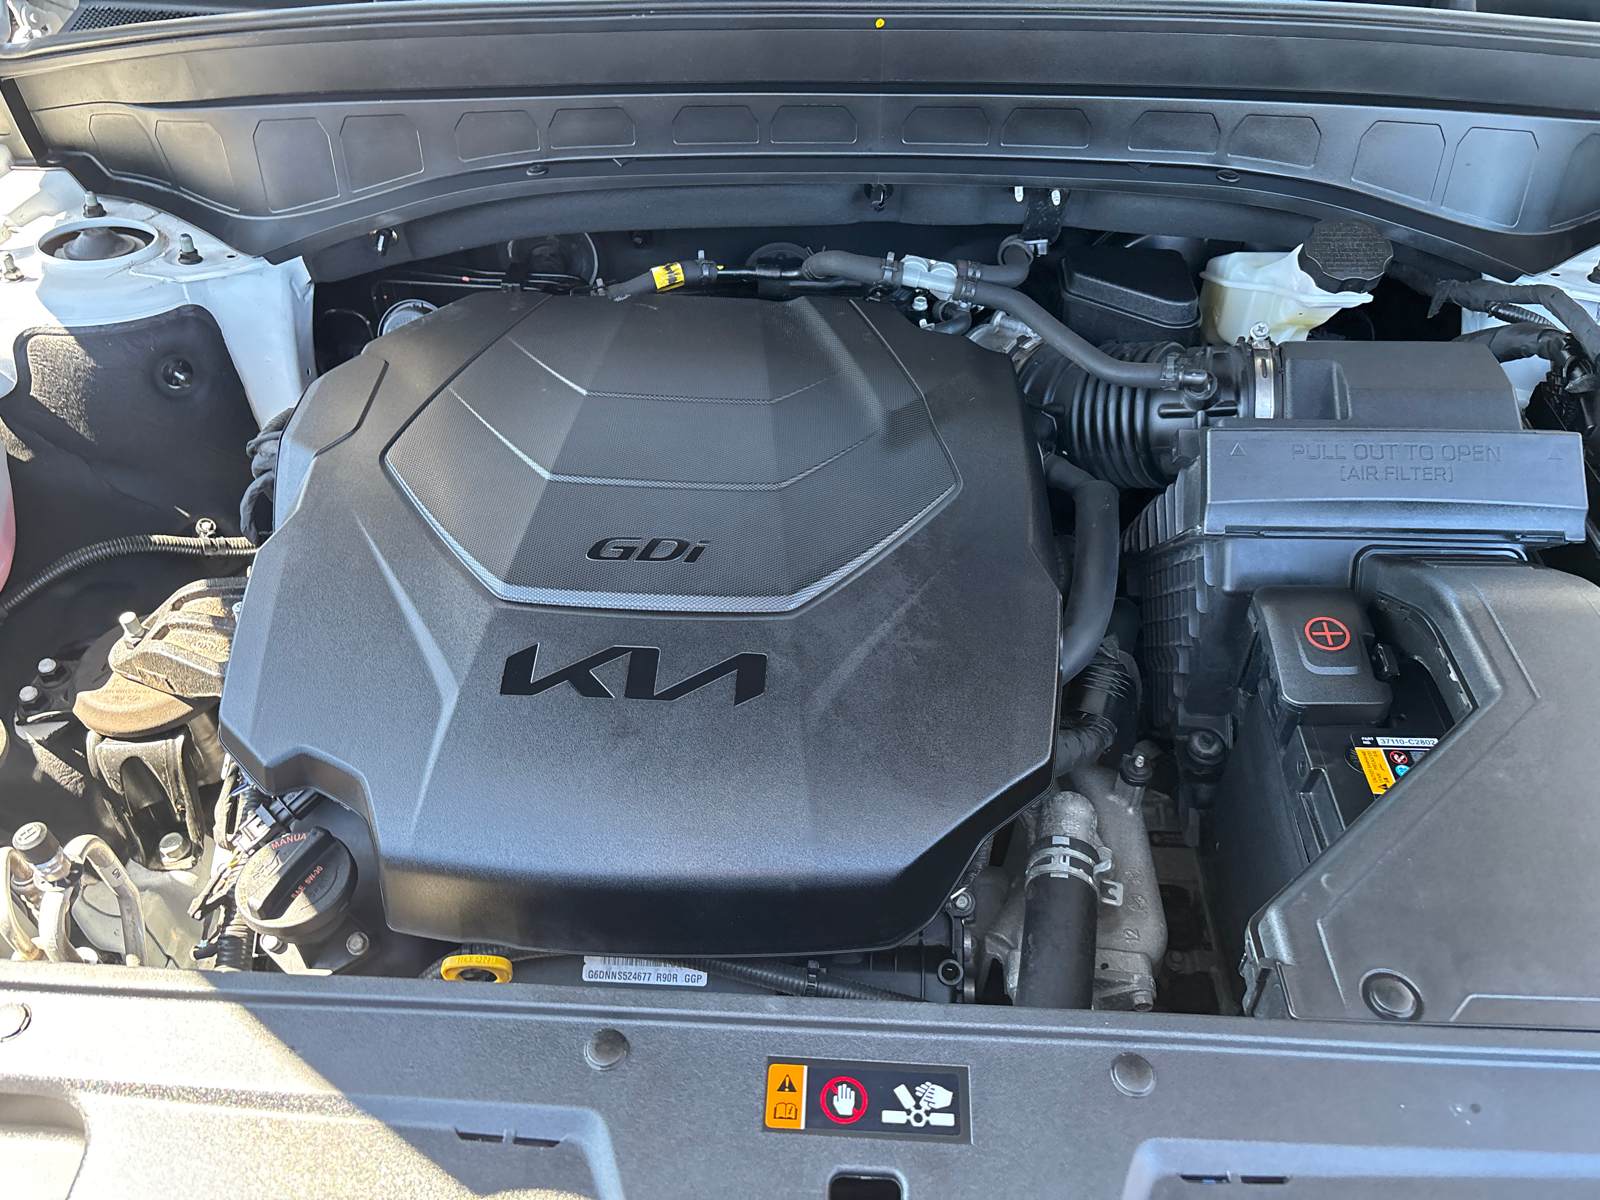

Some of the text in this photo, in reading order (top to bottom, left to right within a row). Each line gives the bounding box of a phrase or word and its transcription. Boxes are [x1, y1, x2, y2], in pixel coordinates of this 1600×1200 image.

[1291, 443, 1500, 461] PULL OUT TO OPEN
[586, 537, 711, 563] GDi
[500, 642, 768, 707] KIA
[270, 833, 307, 850] MANUA
[588, 970, 703, 984] G6DNNS524677 R90R GGP
